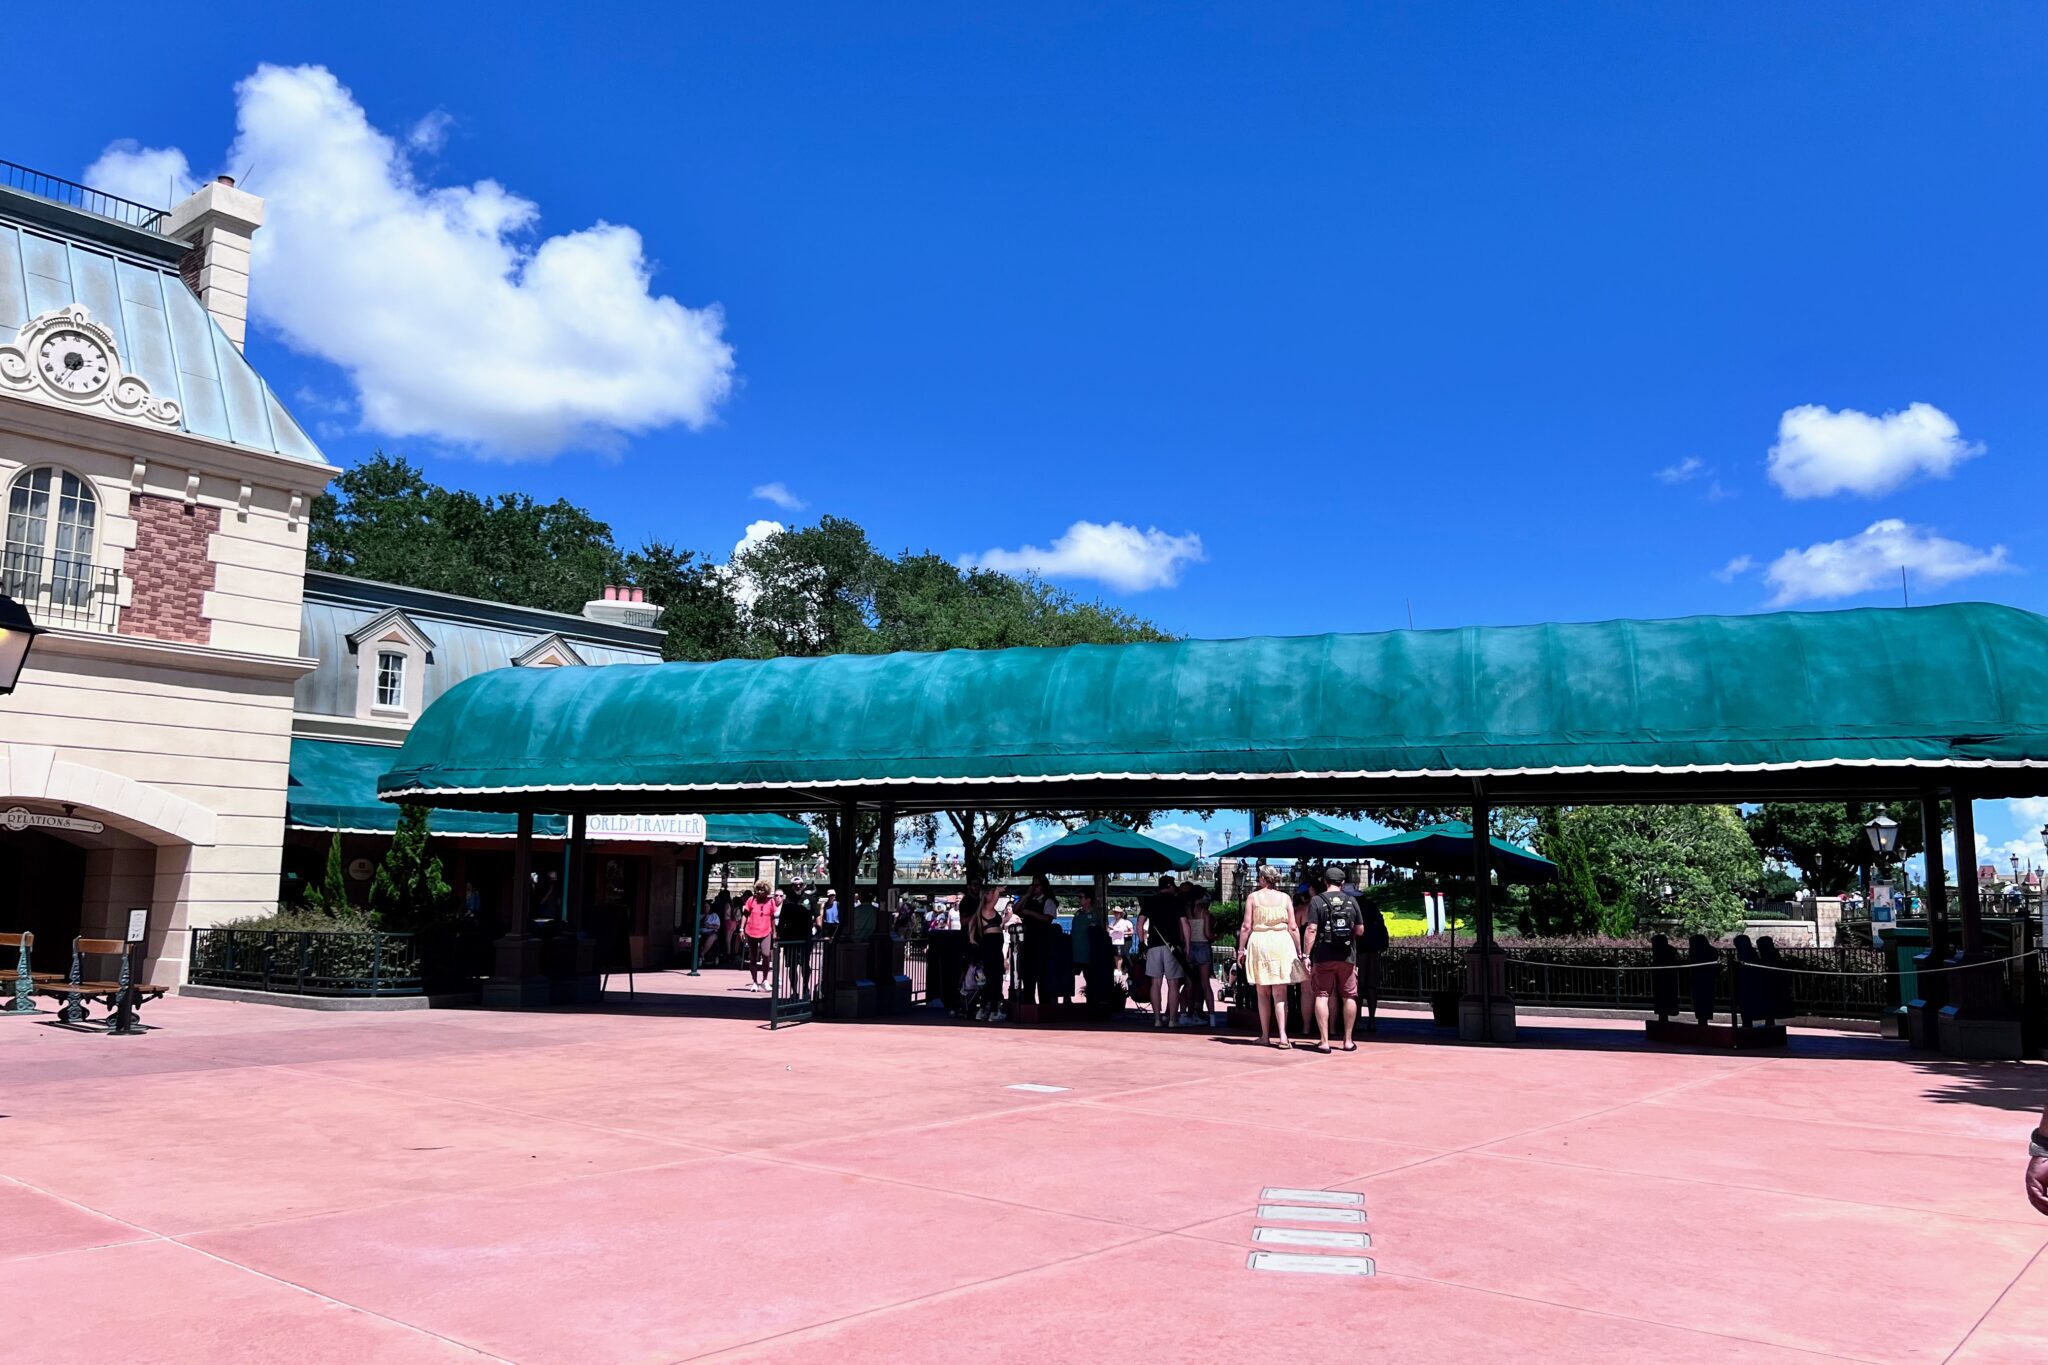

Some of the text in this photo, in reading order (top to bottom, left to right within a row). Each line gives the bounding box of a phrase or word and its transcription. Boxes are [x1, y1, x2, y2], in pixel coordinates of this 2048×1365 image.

[7, 814, 71, 827] RELATIONS
[586, 816, 700, 834] ORLD TRAVELER
